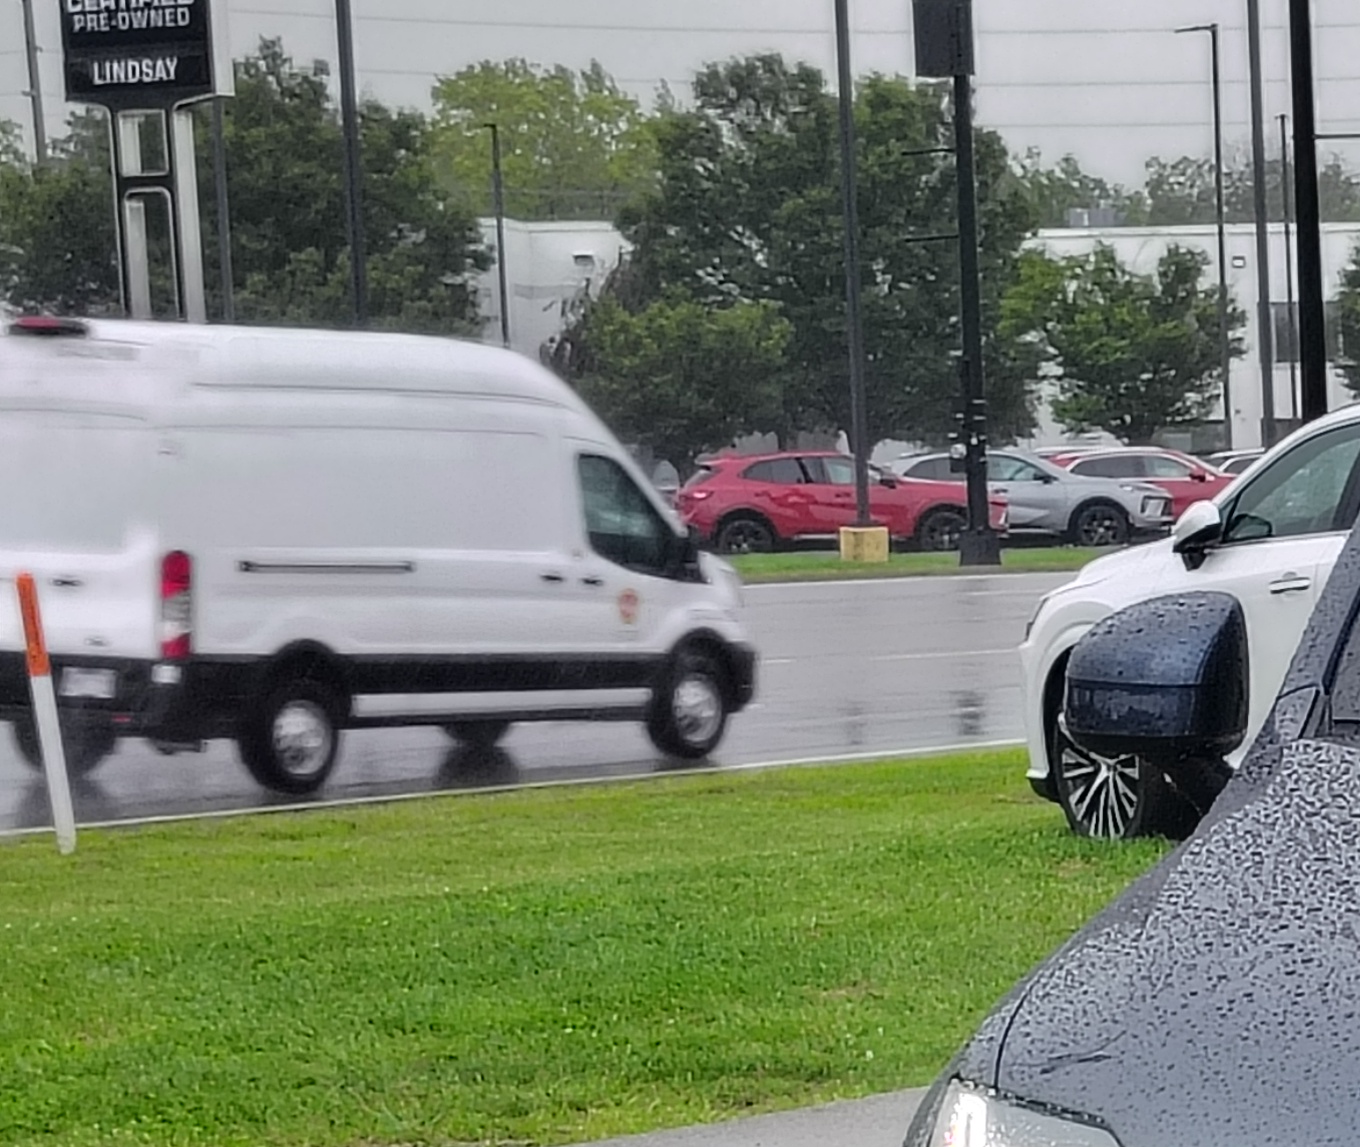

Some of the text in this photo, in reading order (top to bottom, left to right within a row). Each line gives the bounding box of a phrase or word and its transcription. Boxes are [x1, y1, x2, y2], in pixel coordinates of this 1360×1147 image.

[67, 0, 195, 12] CERTI
[73, 7, 190, 32] PRE-OWNED
[93, 56, 178, 85] LINDSAY
